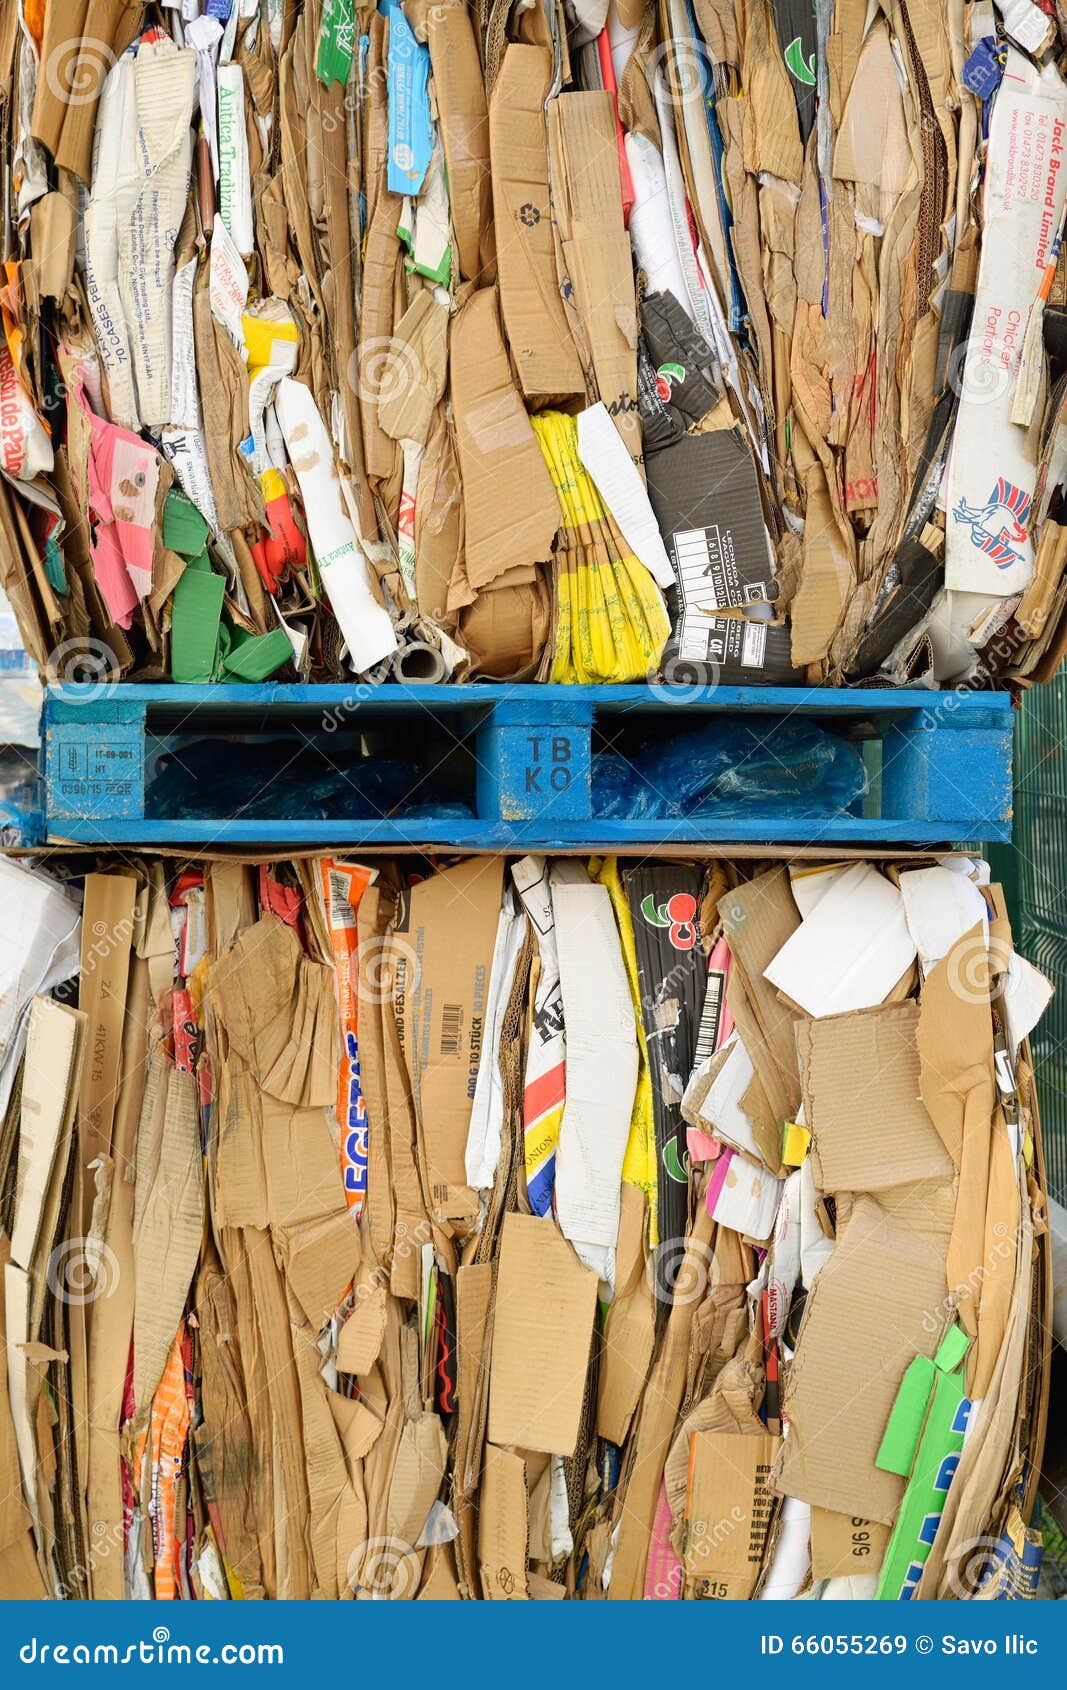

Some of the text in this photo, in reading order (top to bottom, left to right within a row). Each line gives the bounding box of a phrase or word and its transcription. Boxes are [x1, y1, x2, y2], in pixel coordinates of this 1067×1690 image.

[219, 86, 237, 146] Antica
[1052, 116, 1066, 154] Jack
[1045, 157, 1061, 206] Brand
[1035, 208, 1056, 270] Limited
[99, 303, 121, 346] CASES
[1003, 309, 1021, 371] Chicken
[115, 346, 126, 364] 70
[721, 536, 733, 587] VACUUM
[727, 530, 740, 587] LECHUGA
[714, 575, 722, 584] 10
[716, 587, 724, 596] 12
[718, 598, 727, 607] 15
[716, 620, 725, 629] 18
[710, 638, 723, 655] CAT
[95, 765, 106, 773] HT
[395, 958, 407, 1015] GESALZEN
[474, 965, 486, 998] PIECES
[469, 1017, 482, 1050] STÜCK
[470, 1052, 480, 1063] 10
[467, 1078, 478, 1099] 400
[524, 1135, 554, 1166] ONION
[768, 1288, 778, 1330] MASTANA
[752, 1509, 765, 1518] THE
